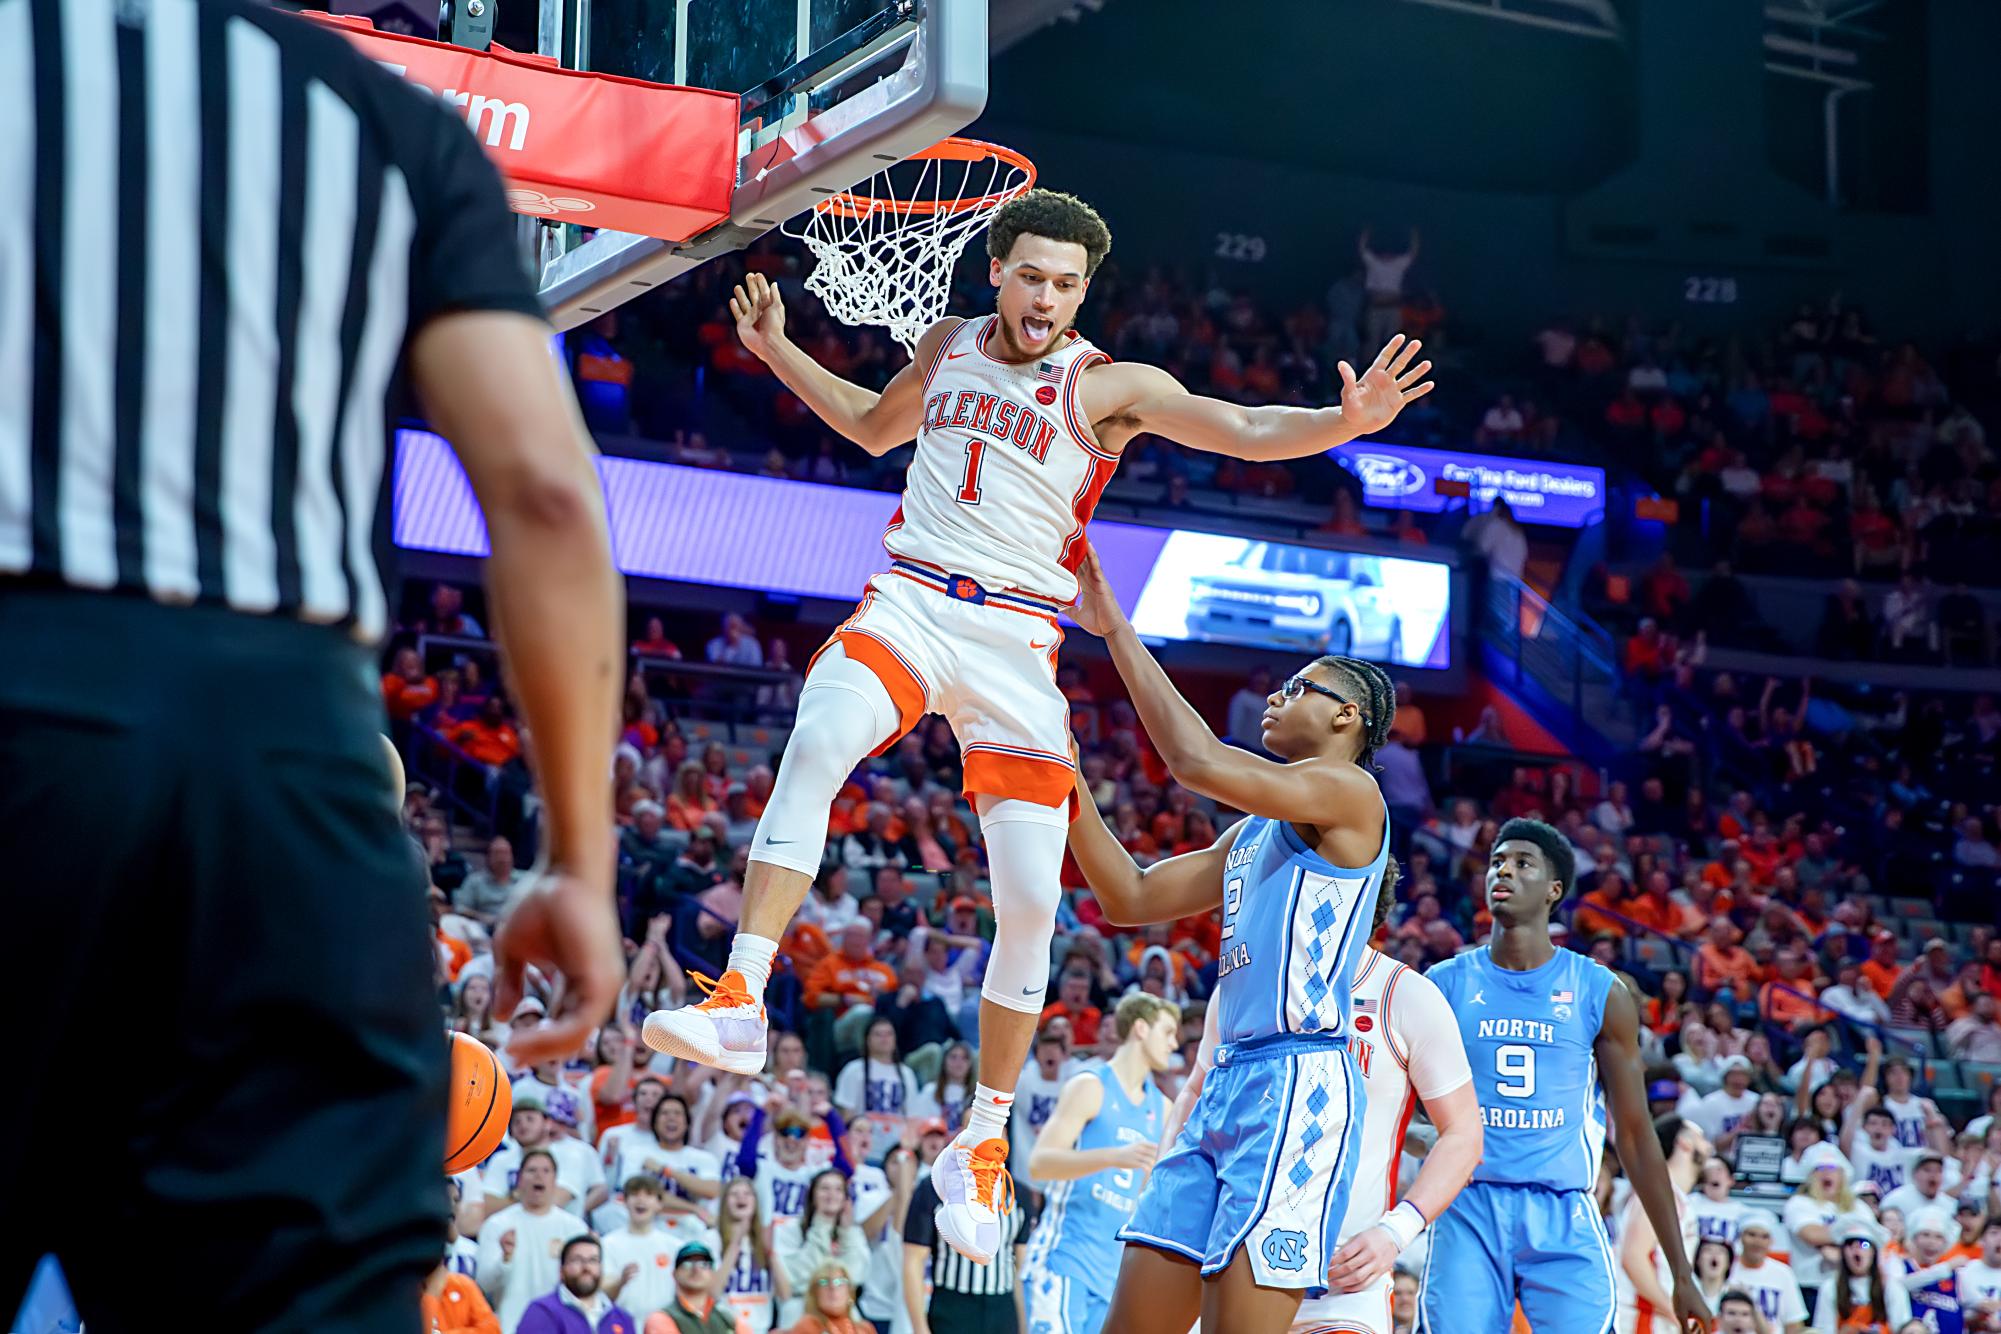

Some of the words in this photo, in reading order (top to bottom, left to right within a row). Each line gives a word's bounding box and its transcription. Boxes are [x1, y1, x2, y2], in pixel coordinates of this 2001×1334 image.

[1215, 233, 1266, 261] 229
[924, 391, 1058, 465] CLEMSON
[956, 438, 987, 505] 1
[1221, 876, 1243, 941] 2
[1478, 1018, 1555, 1043] NORTH
[1496, 1044, 1536, 1098] 9
[1479, 1106, 1566, 1130] AROLINA
